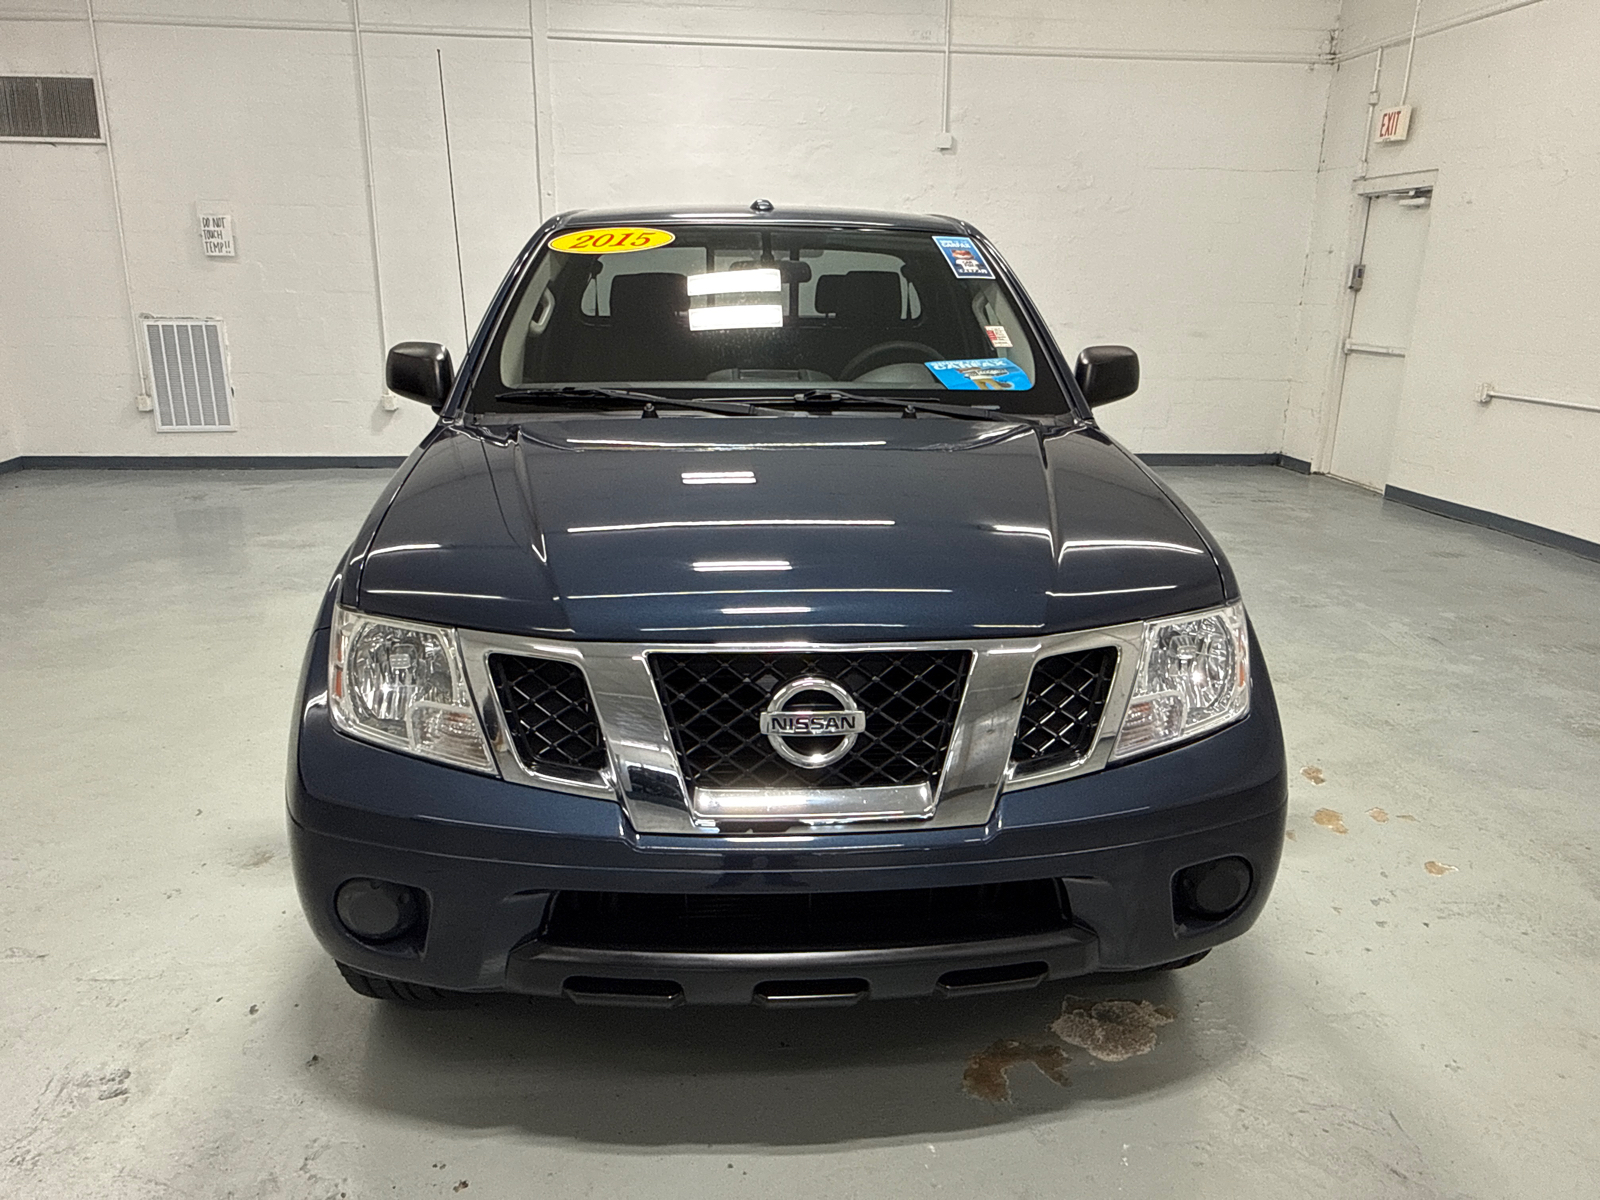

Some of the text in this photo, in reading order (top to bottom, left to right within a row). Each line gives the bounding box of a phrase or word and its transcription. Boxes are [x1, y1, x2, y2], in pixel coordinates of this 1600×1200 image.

[1379, 111, 1401, 137] EXIT
[202, 217, 226, 228] DO NOT
[202, 229, 223, 240] TOUCH
[569, 232, 656, 249] 2015
[204, 241, 231, 254] TEMP!!
[933, 360, 1007, 371] CARFAX
[771, 716, 856, 730] NISSAN
